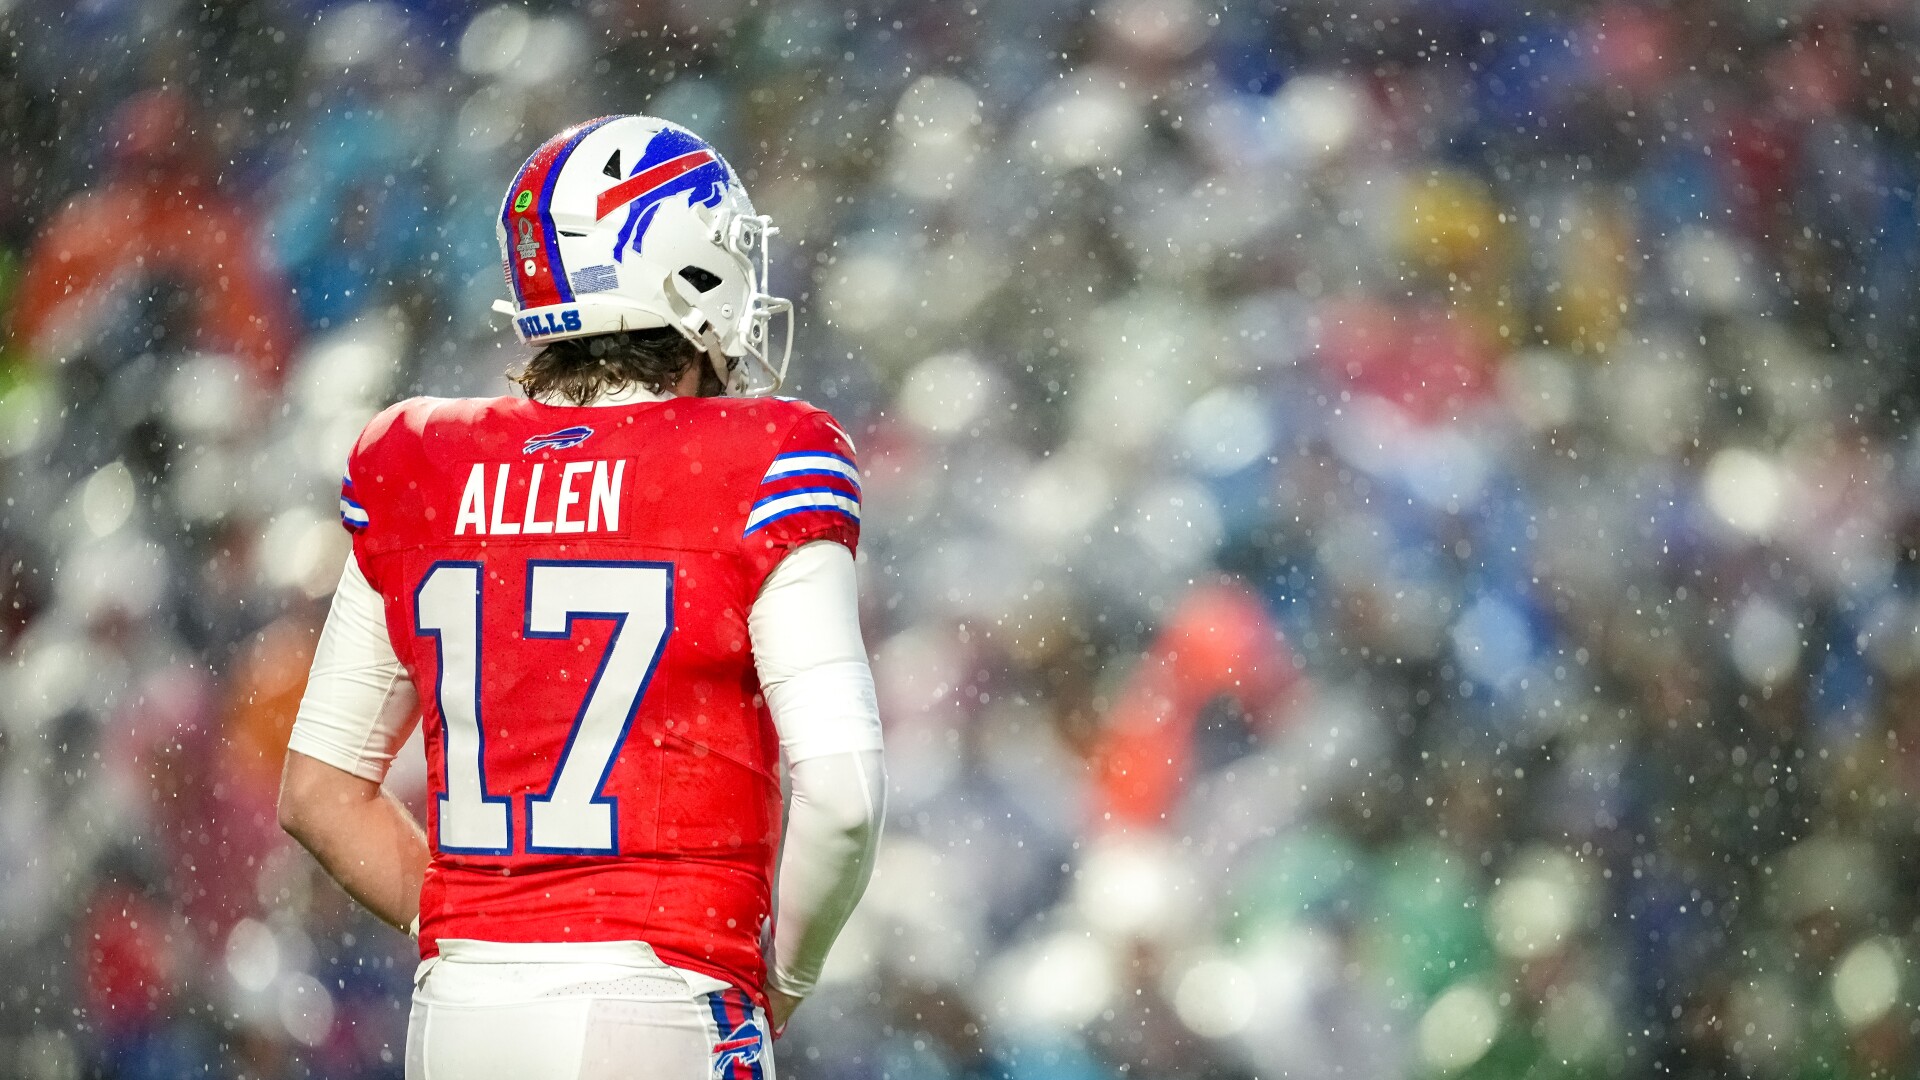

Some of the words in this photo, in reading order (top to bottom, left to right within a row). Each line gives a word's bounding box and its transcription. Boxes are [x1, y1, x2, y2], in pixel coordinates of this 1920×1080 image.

[517, 309, 582, 338] BILLS
[454, 459, 626, 536] ALLEN
[414, 559, 675, 856] 17
